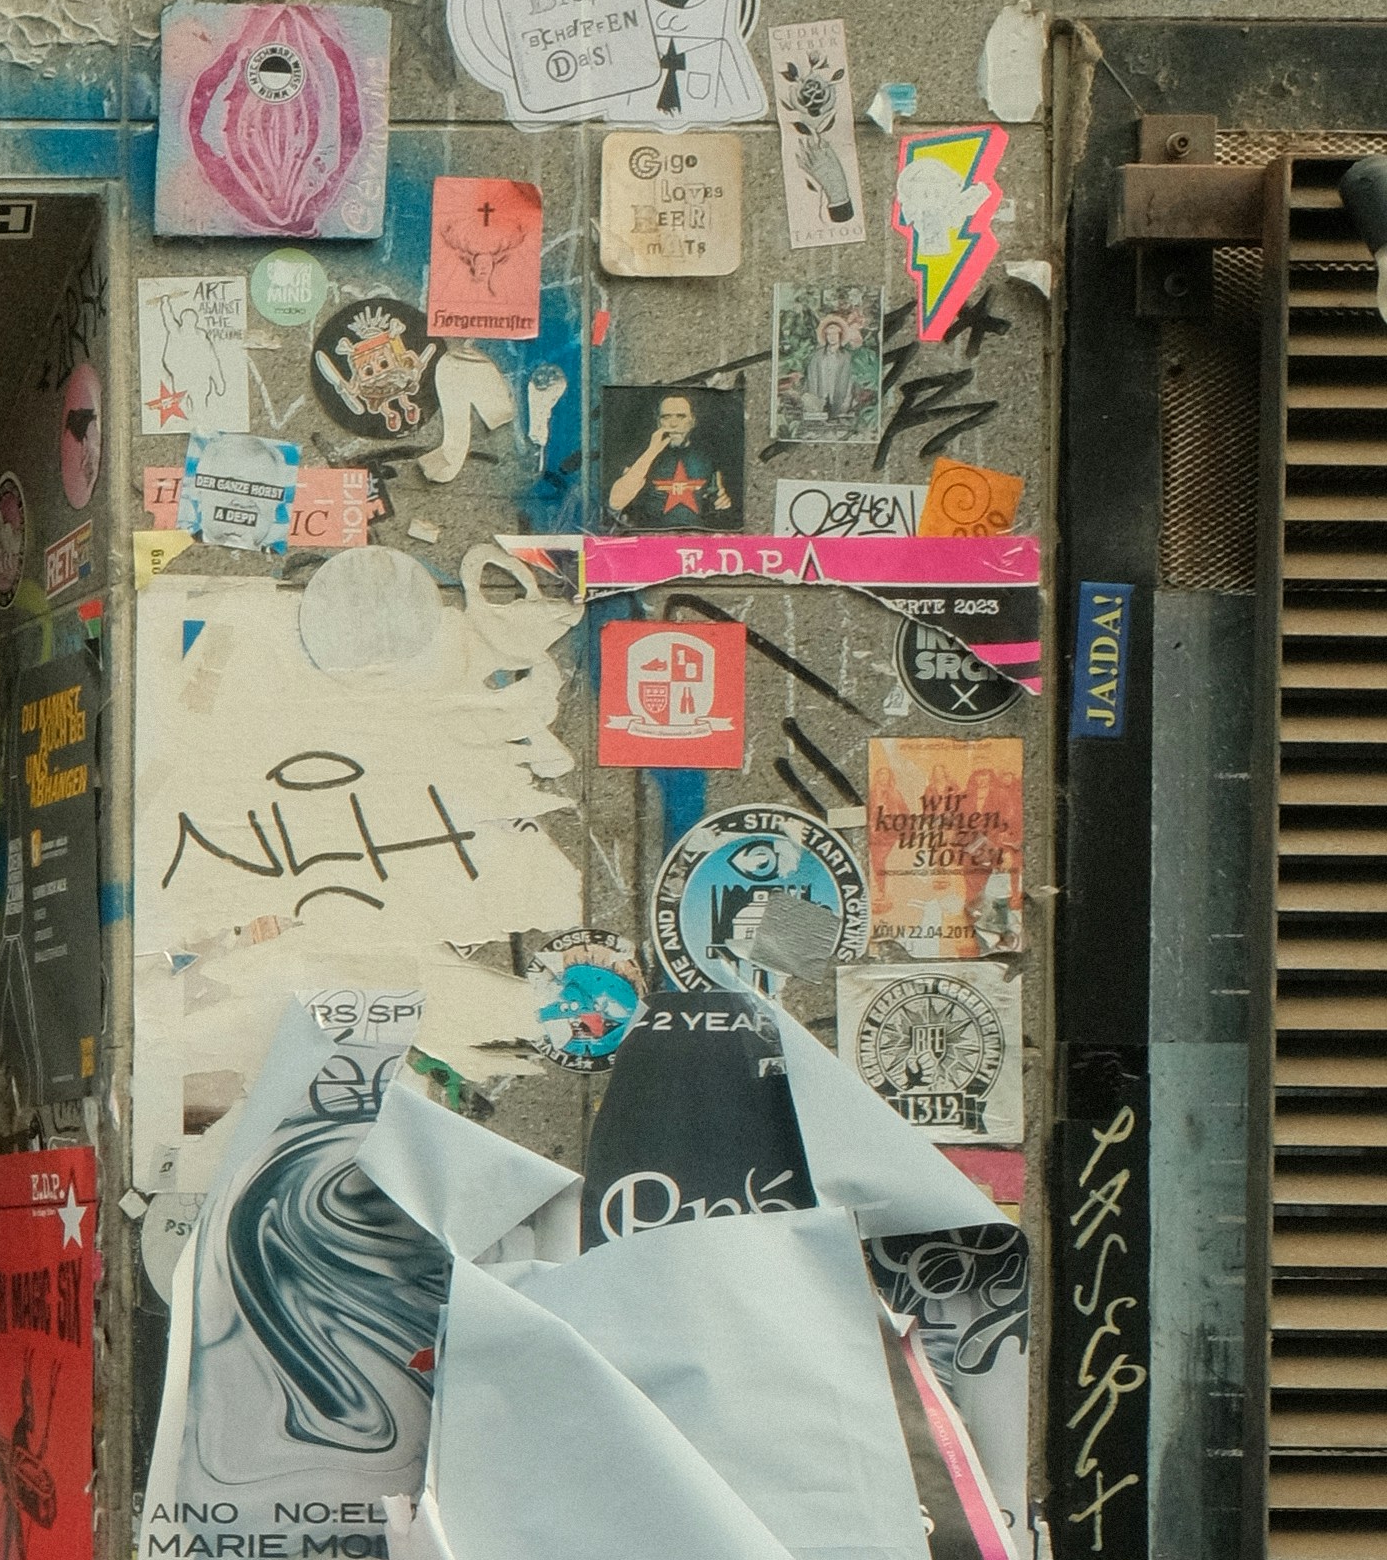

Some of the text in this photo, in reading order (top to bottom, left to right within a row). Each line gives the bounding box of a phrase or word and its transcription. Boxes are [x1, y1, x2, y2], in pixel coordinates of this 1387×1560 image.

[773, 23, 841, 40] CEDRIC
[778, 37, 839, 54] WEBER
[792, 226, 865, 241] TATTOO
[194, 282, 230, 301] ART
[267, 287, 312, 303] MIND
[199, 300, 240, 315] AGAINST
[205, 316, 231, 327] THE
[197, 475, 284, 499] DER GANZE HORST
[215, 508, 256, 525] A DEPP
[954, 600, 999, 615] 2023
[1087, 594, 1123, 727] JA!DA!
[908, 925, 977, 938] 22.04.2017
[907, 1095, 960, 1124] 1312
[149, 1501, 239, 1526] AINO
[147, 1533, 289, 1560] MARIE
